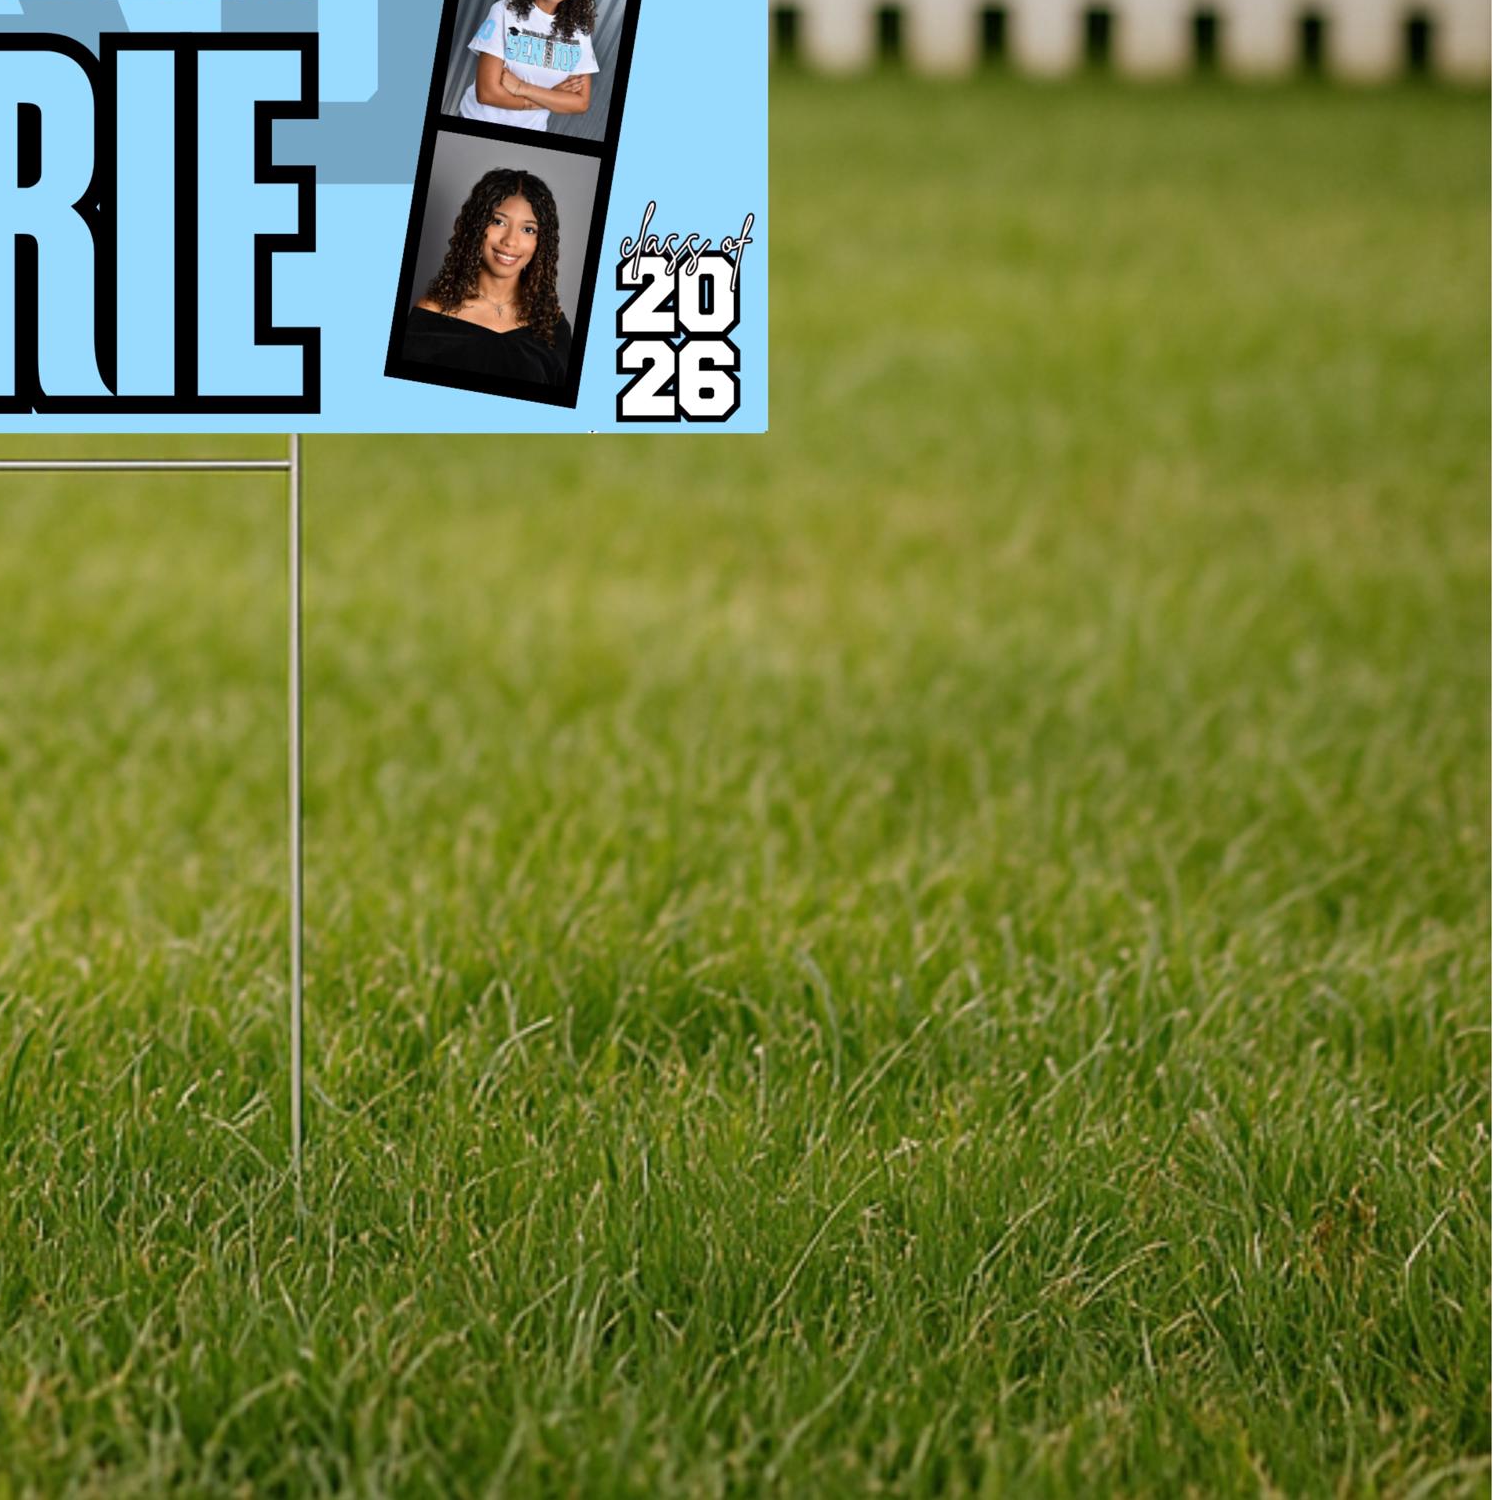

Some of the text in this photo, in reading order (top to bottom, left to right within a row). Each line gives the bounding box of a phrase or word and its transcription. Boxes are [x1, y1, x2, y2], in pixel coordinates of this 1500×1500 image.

[620, 200, 755, 292] class of
[616, 250, 740, 338] 20
[616, 338, 740, 422] 26
